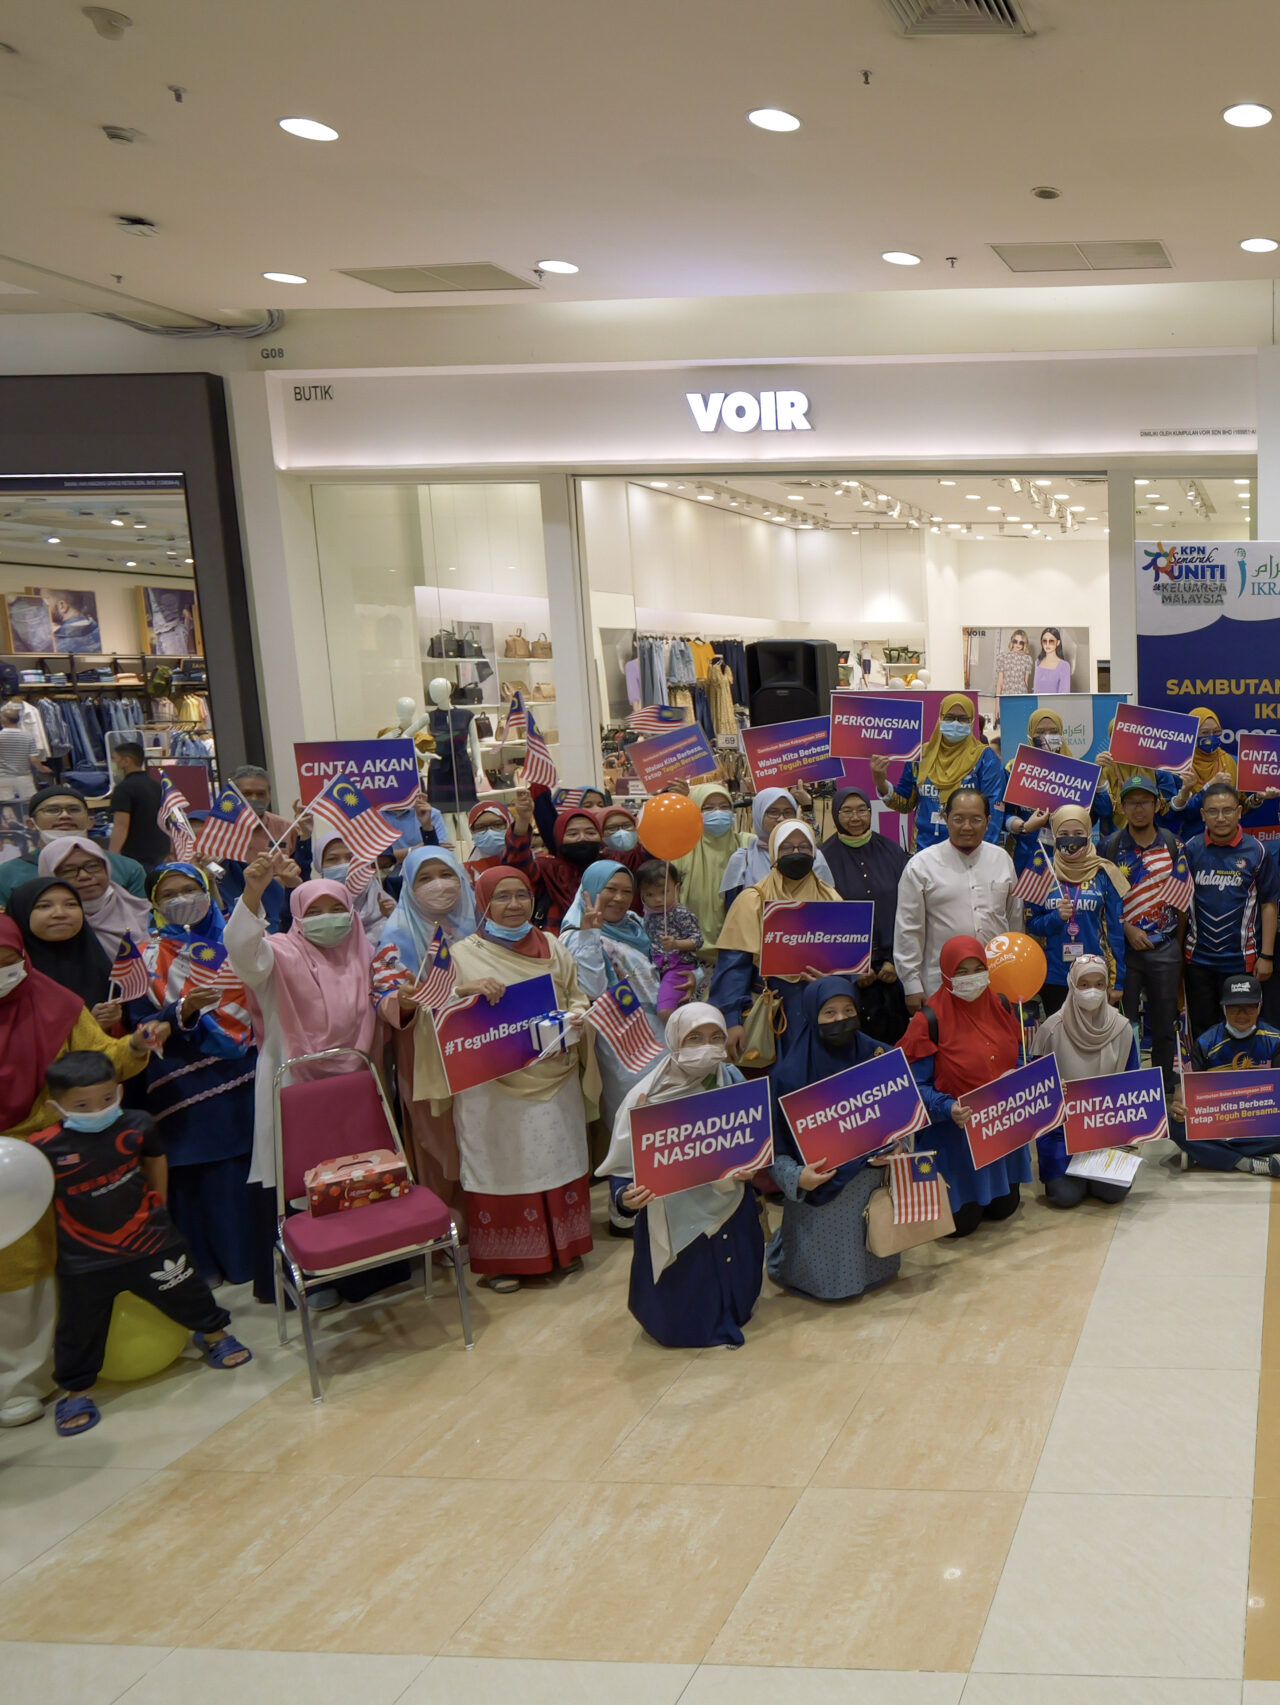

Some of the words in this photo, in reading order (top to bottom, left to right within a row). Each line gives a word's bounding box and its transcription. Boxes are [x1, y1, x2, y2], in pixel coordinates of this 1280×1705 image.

[261, 348, 284, 359] G08
[294, 385, 333, 401] BUTIK
[685, 391, 814, 433] VOIR
[1168, 548, 1219, 564] Semarak
[1180, 546, 1206, 555] KPN
[1172, 564, 1226, 581] UNITI
[1161, 593, 1225, 605] MALAYSIA
[834, 714, 920, 730] PERKONGSIAN
[861, 728, 892, 740] NILAI
[1116, 721, 1194, 744] PERKONGSIAN
[1138, 737, 1167, 751] NILAI
[758, 756, 782, 767] Walau
[782, 752, 798, 762] Kita
[1240, 750, 1278, 763] CINTA
[300, 760, 359, 776] CINTA
[362, 757, 413, 774] AKAN
[755, 767, 778, 778] Tetap
[779, 761, 802, 772] Teguh
[1017, 762, 1093, 791] PERPADUAN
[1019, 776, 1081, 802] NASIONAL
[1195, 869, 1243, 891] Malaysia
[764, 931, 869, 946] #TeguhBersama
[796, 1074, 910, 1134] PERKONGSIAN
[971, 1076, 1055, 1128] PERPADUAN
[1066, 1096, 1114, 1116] CINTA
[1116, 1088, 1161, 1107] AKAN
[1194, 1104, 1220, 1115] Walau
[1220, 1102, 1238, 1110] Kita
[1239, 1098, 1276, 1109] Berbeza,
[838, 1104, 881, 1133] NILAI
[981, 1096, 1052, 1140] NASIONAL
[1083, 1107, 1148, 1130] NEGARA
[1190, 1116, 1213, 1125] Tetap
[1214, 1111, 1240, 1122] Teguh
[1241, 1107, 1280, 1118] Bersama.
[641, 1105, 763, 1151] PERPADUAN
[654, 1128, 755, 1168] NASIONAL
[158, 1267, 194, 1291] adidas
